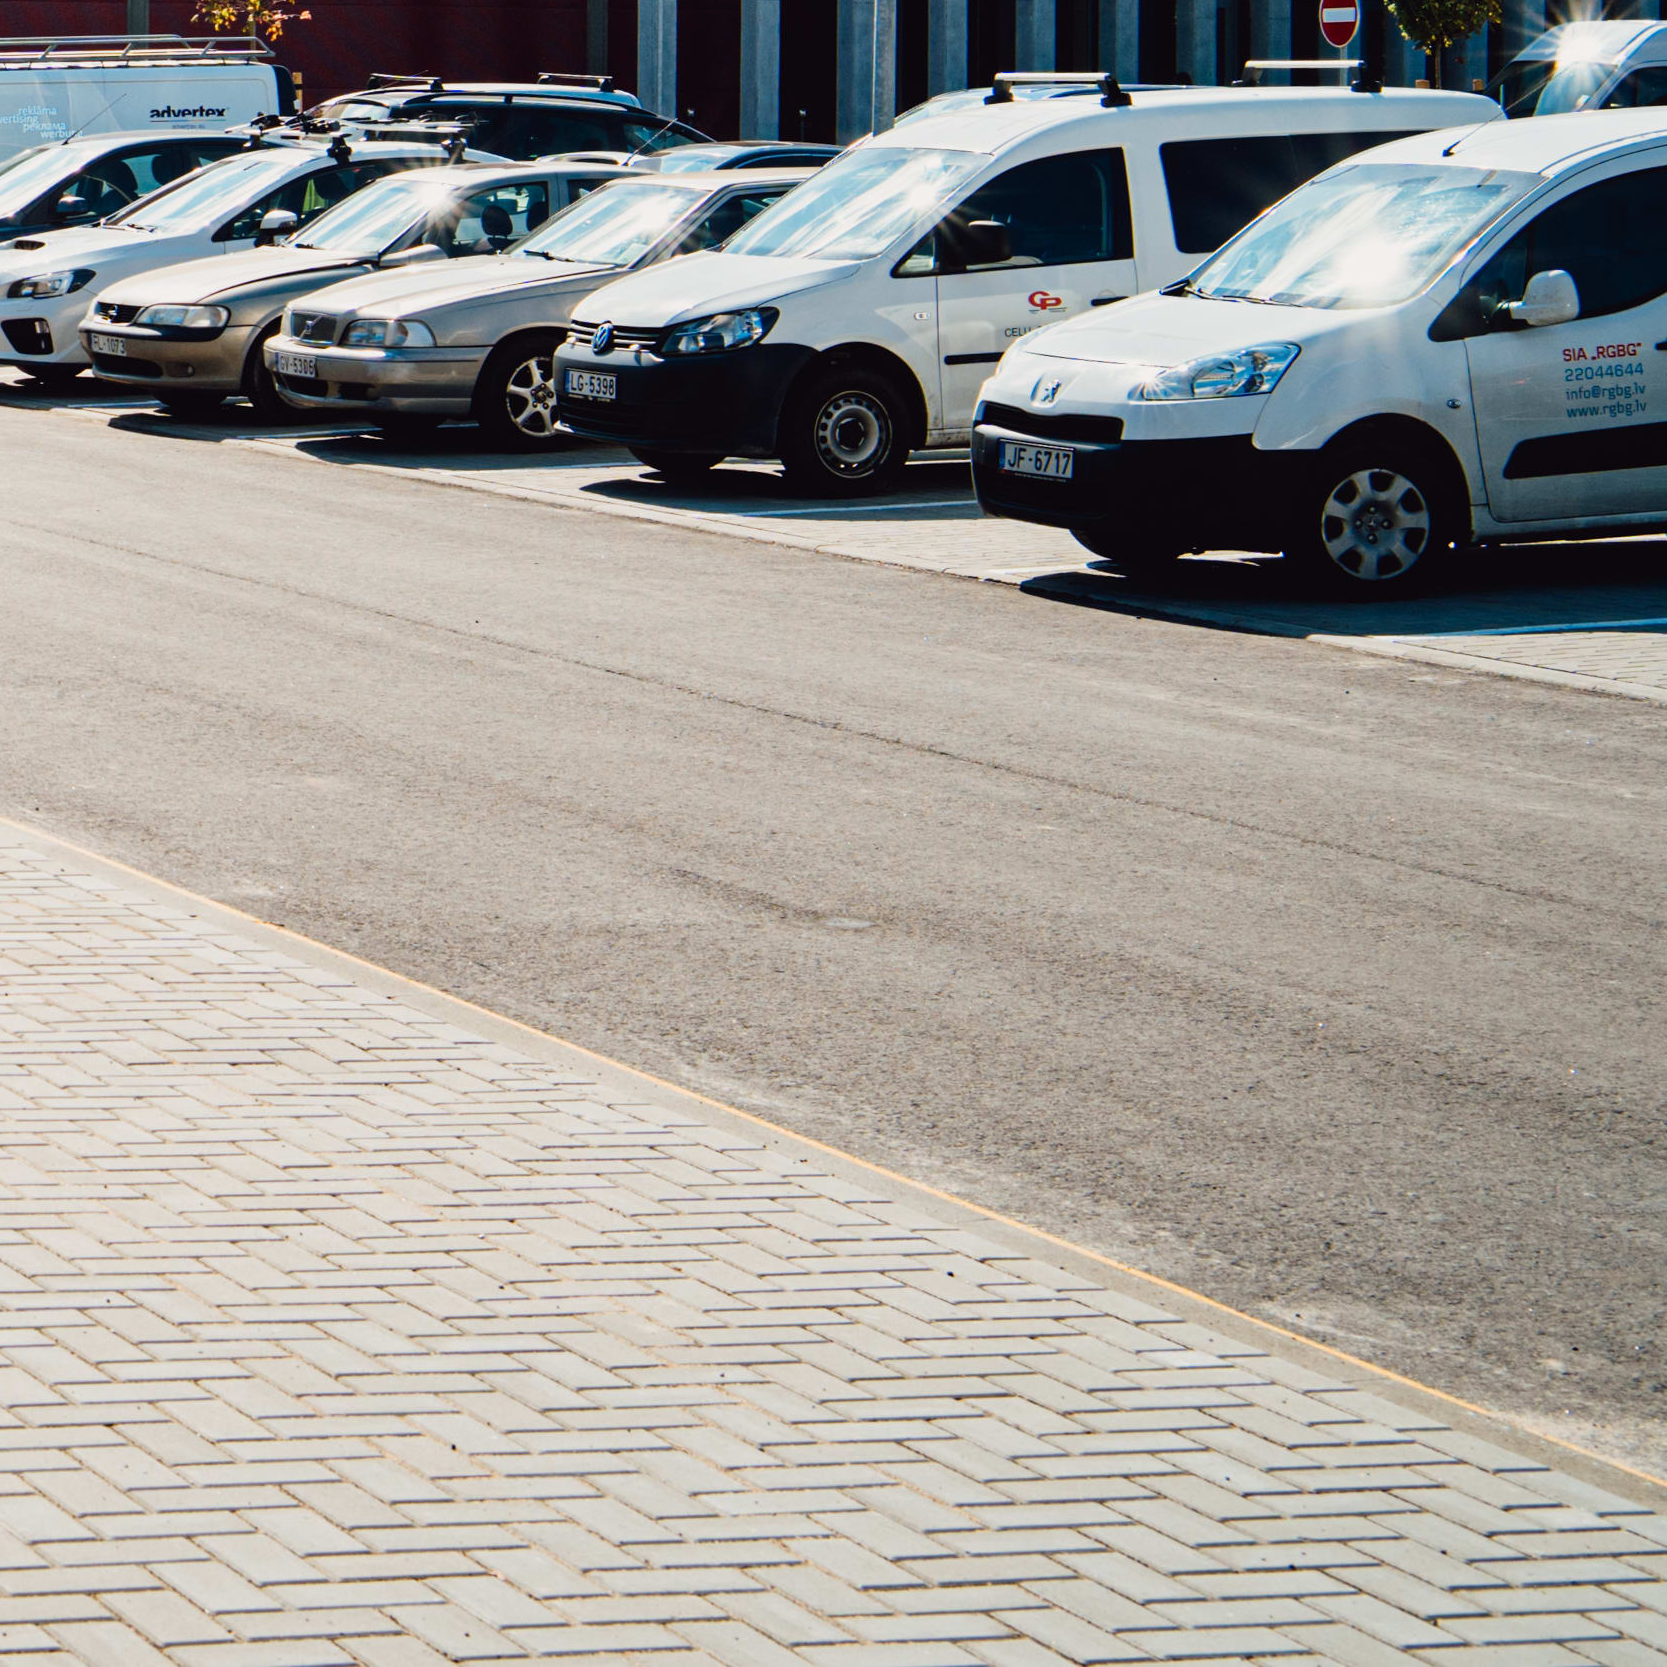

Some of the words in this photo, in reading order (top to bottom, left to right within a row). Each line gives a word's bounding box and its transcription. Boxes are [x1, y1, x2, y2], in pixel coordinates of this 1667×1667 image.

[150, 105, 226, 118] advertex
[1563, 347, 1587, 362] SIA
[1565, 362, 1644, 382] 22044644
[571, 374, 614, 396] LG-5398
[1565, 381, 1646, 400] info@rgbg.lv
[1567, 399, 1647, 418] www.rgbg.lv
[1008, 446, 1071, 475] JF-6717
